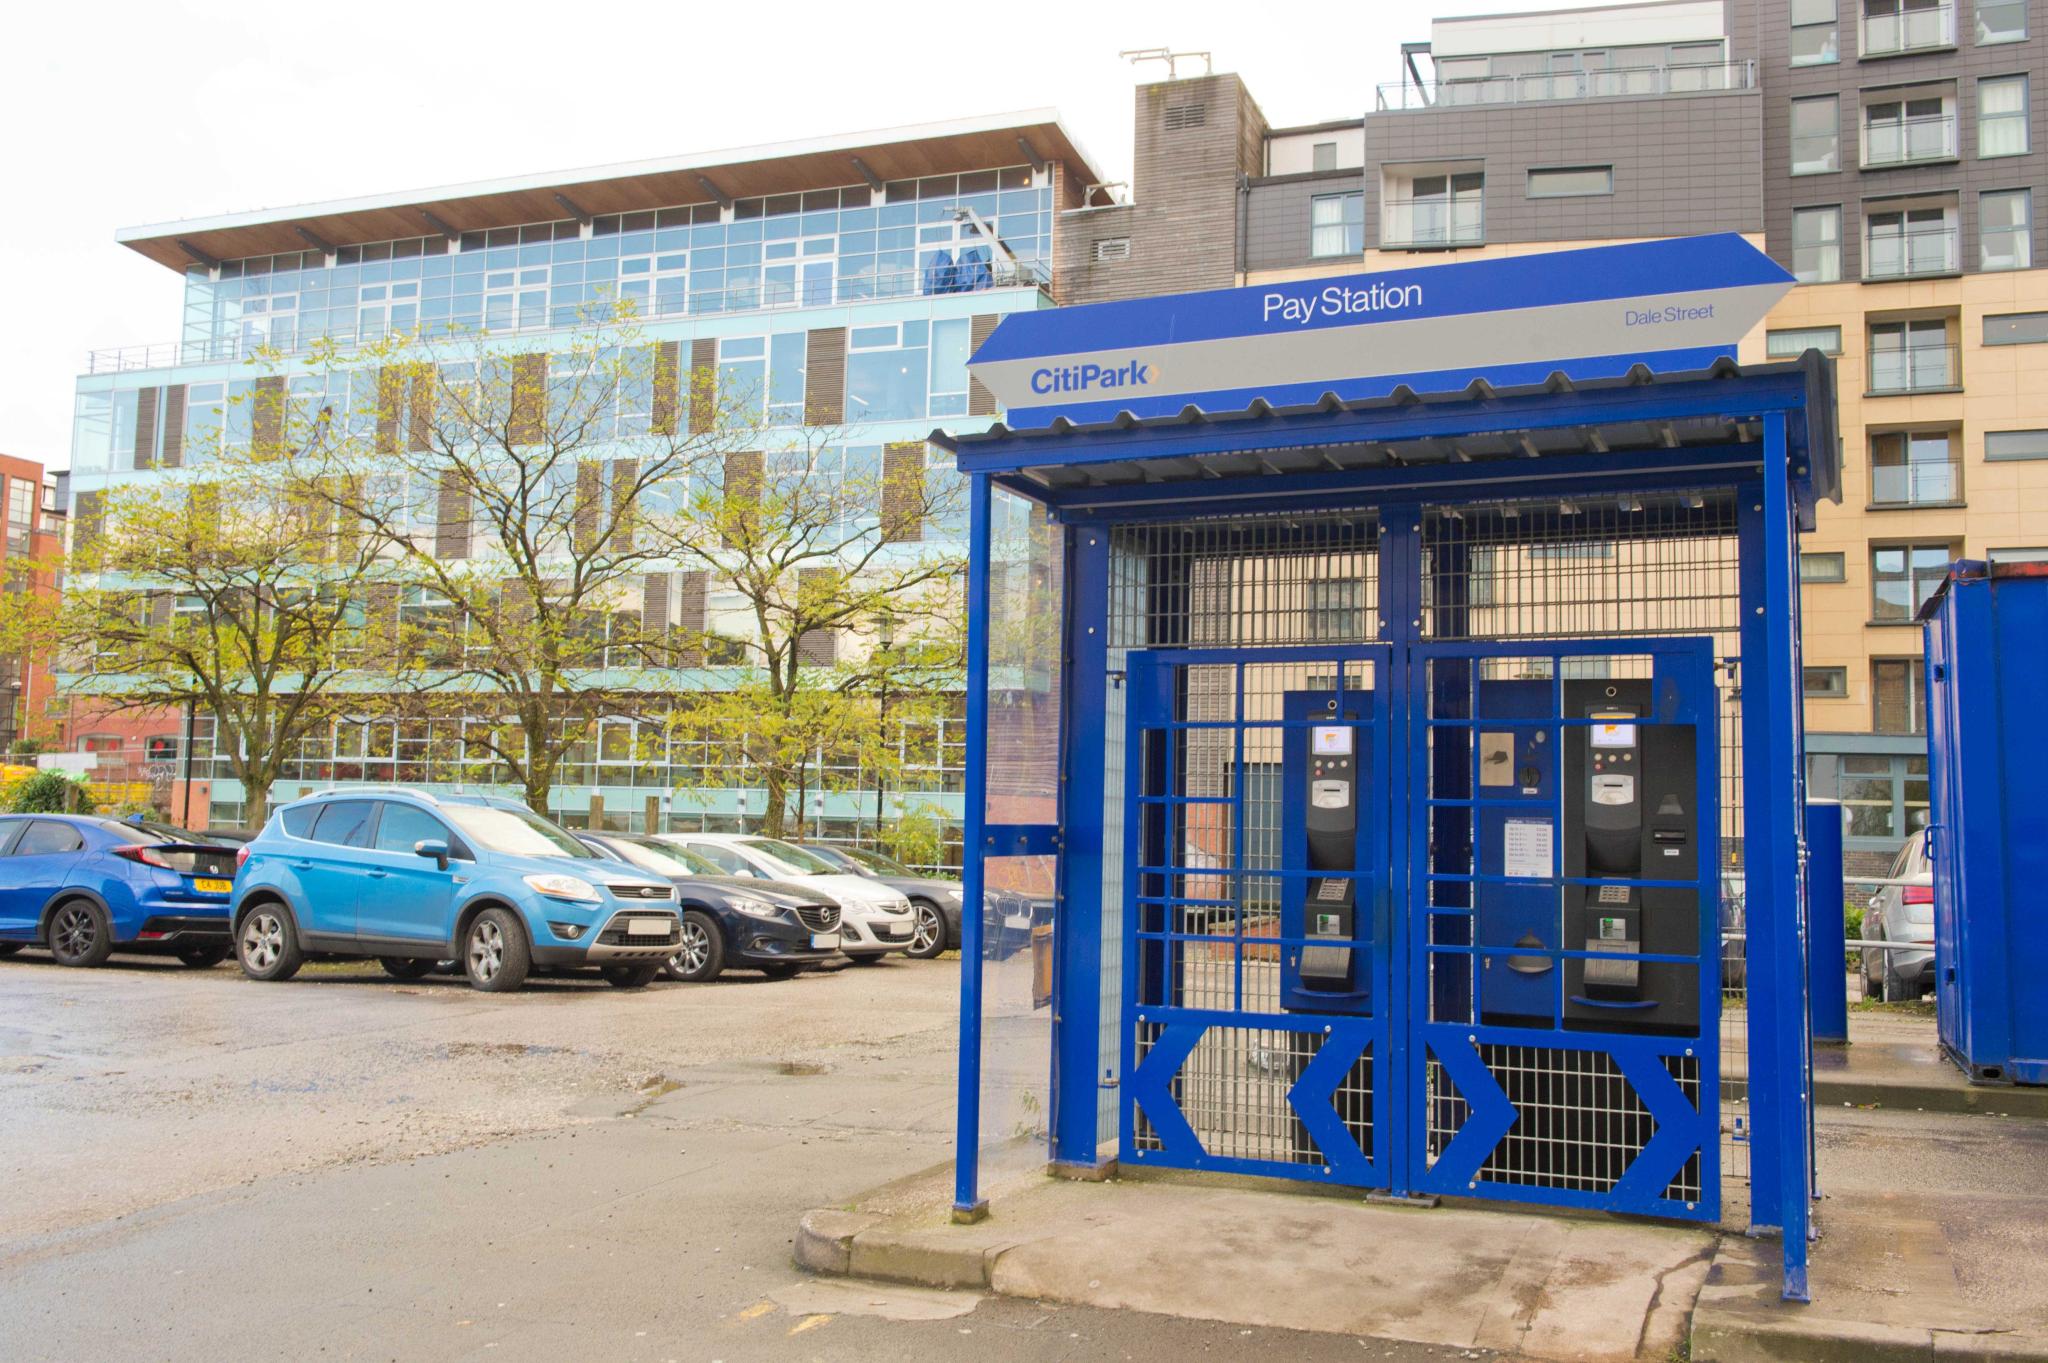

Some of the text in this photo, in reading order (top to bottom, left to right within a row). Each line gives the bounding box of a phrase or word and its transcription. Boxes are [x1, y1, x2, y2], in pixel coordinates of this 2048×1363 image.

[1264, 281, 1423, 324] Pay Station
[1625, 304, 1714, 327] Dale Street
[1031, 360, 1150, 394] CitiPark
